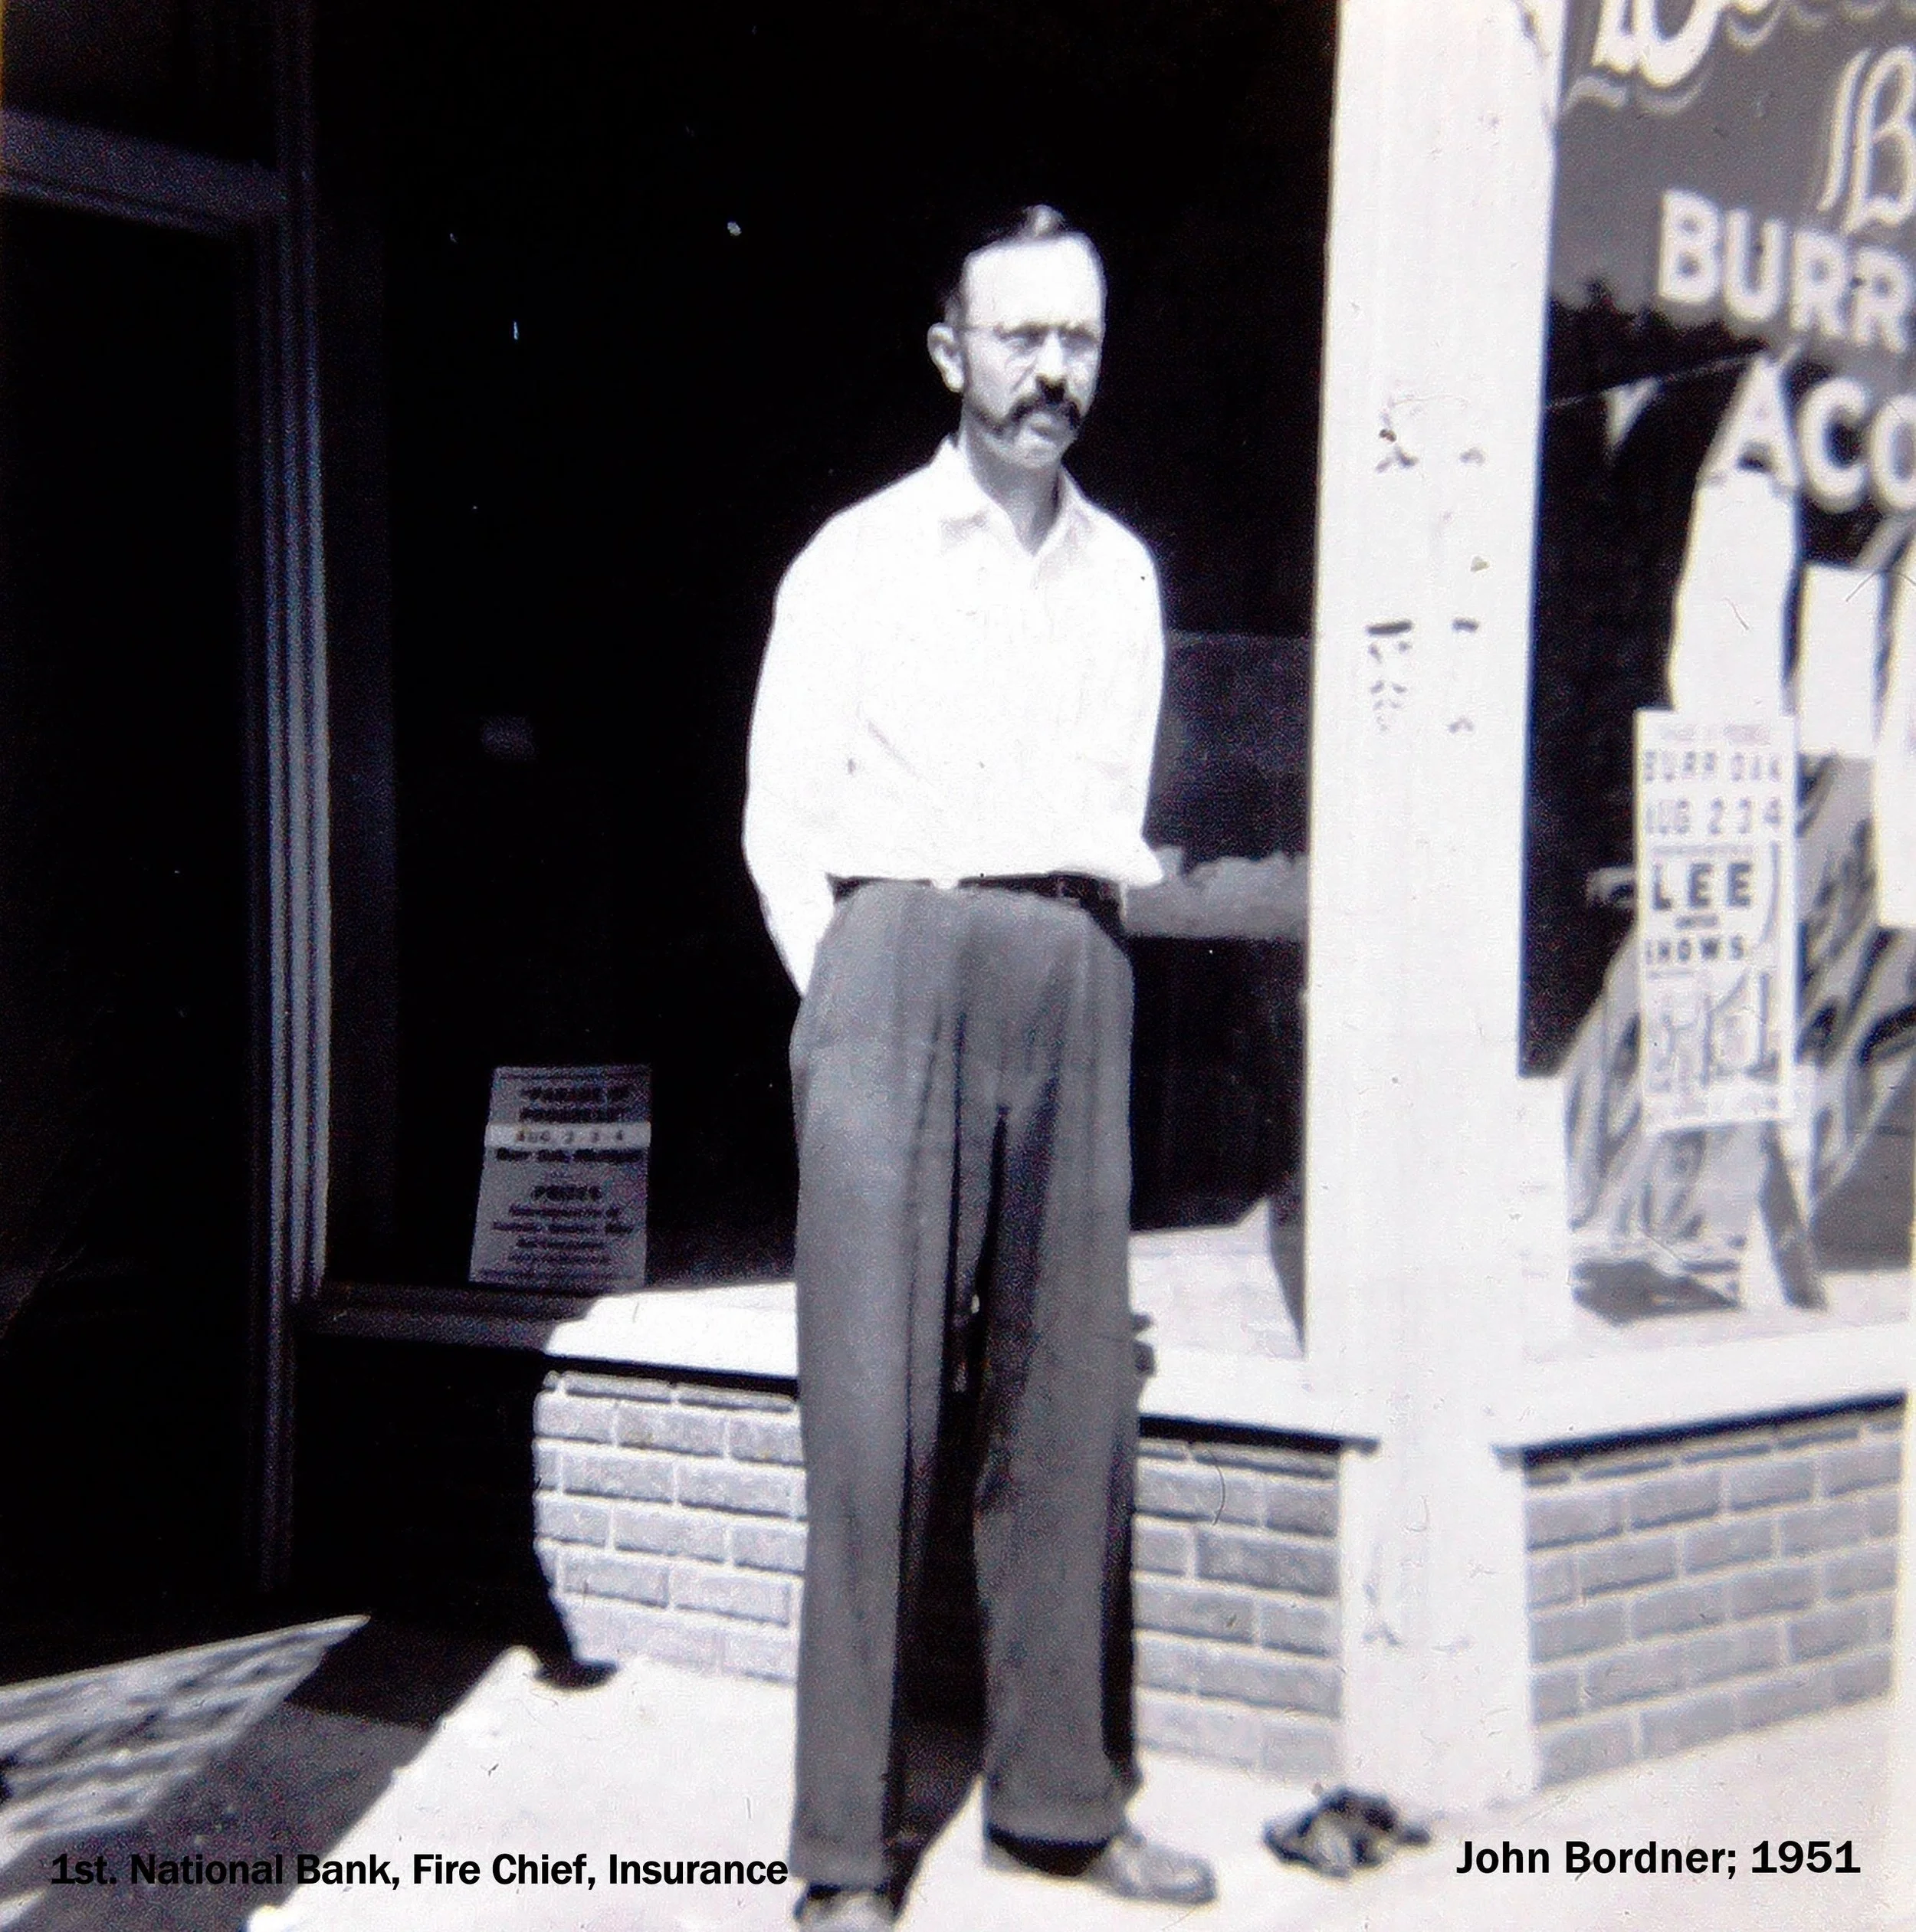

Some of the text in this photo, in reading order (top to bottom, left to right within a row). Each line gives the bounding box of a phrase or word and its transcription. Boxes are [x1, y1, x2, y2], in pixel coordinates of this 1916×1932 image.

[1658, 189, 1911, 354] BURR
[1708, 796, 1726, 835] 2
[1764, 795, 1783, 830] 4
[1652, 861, 1754, 912] LEE
